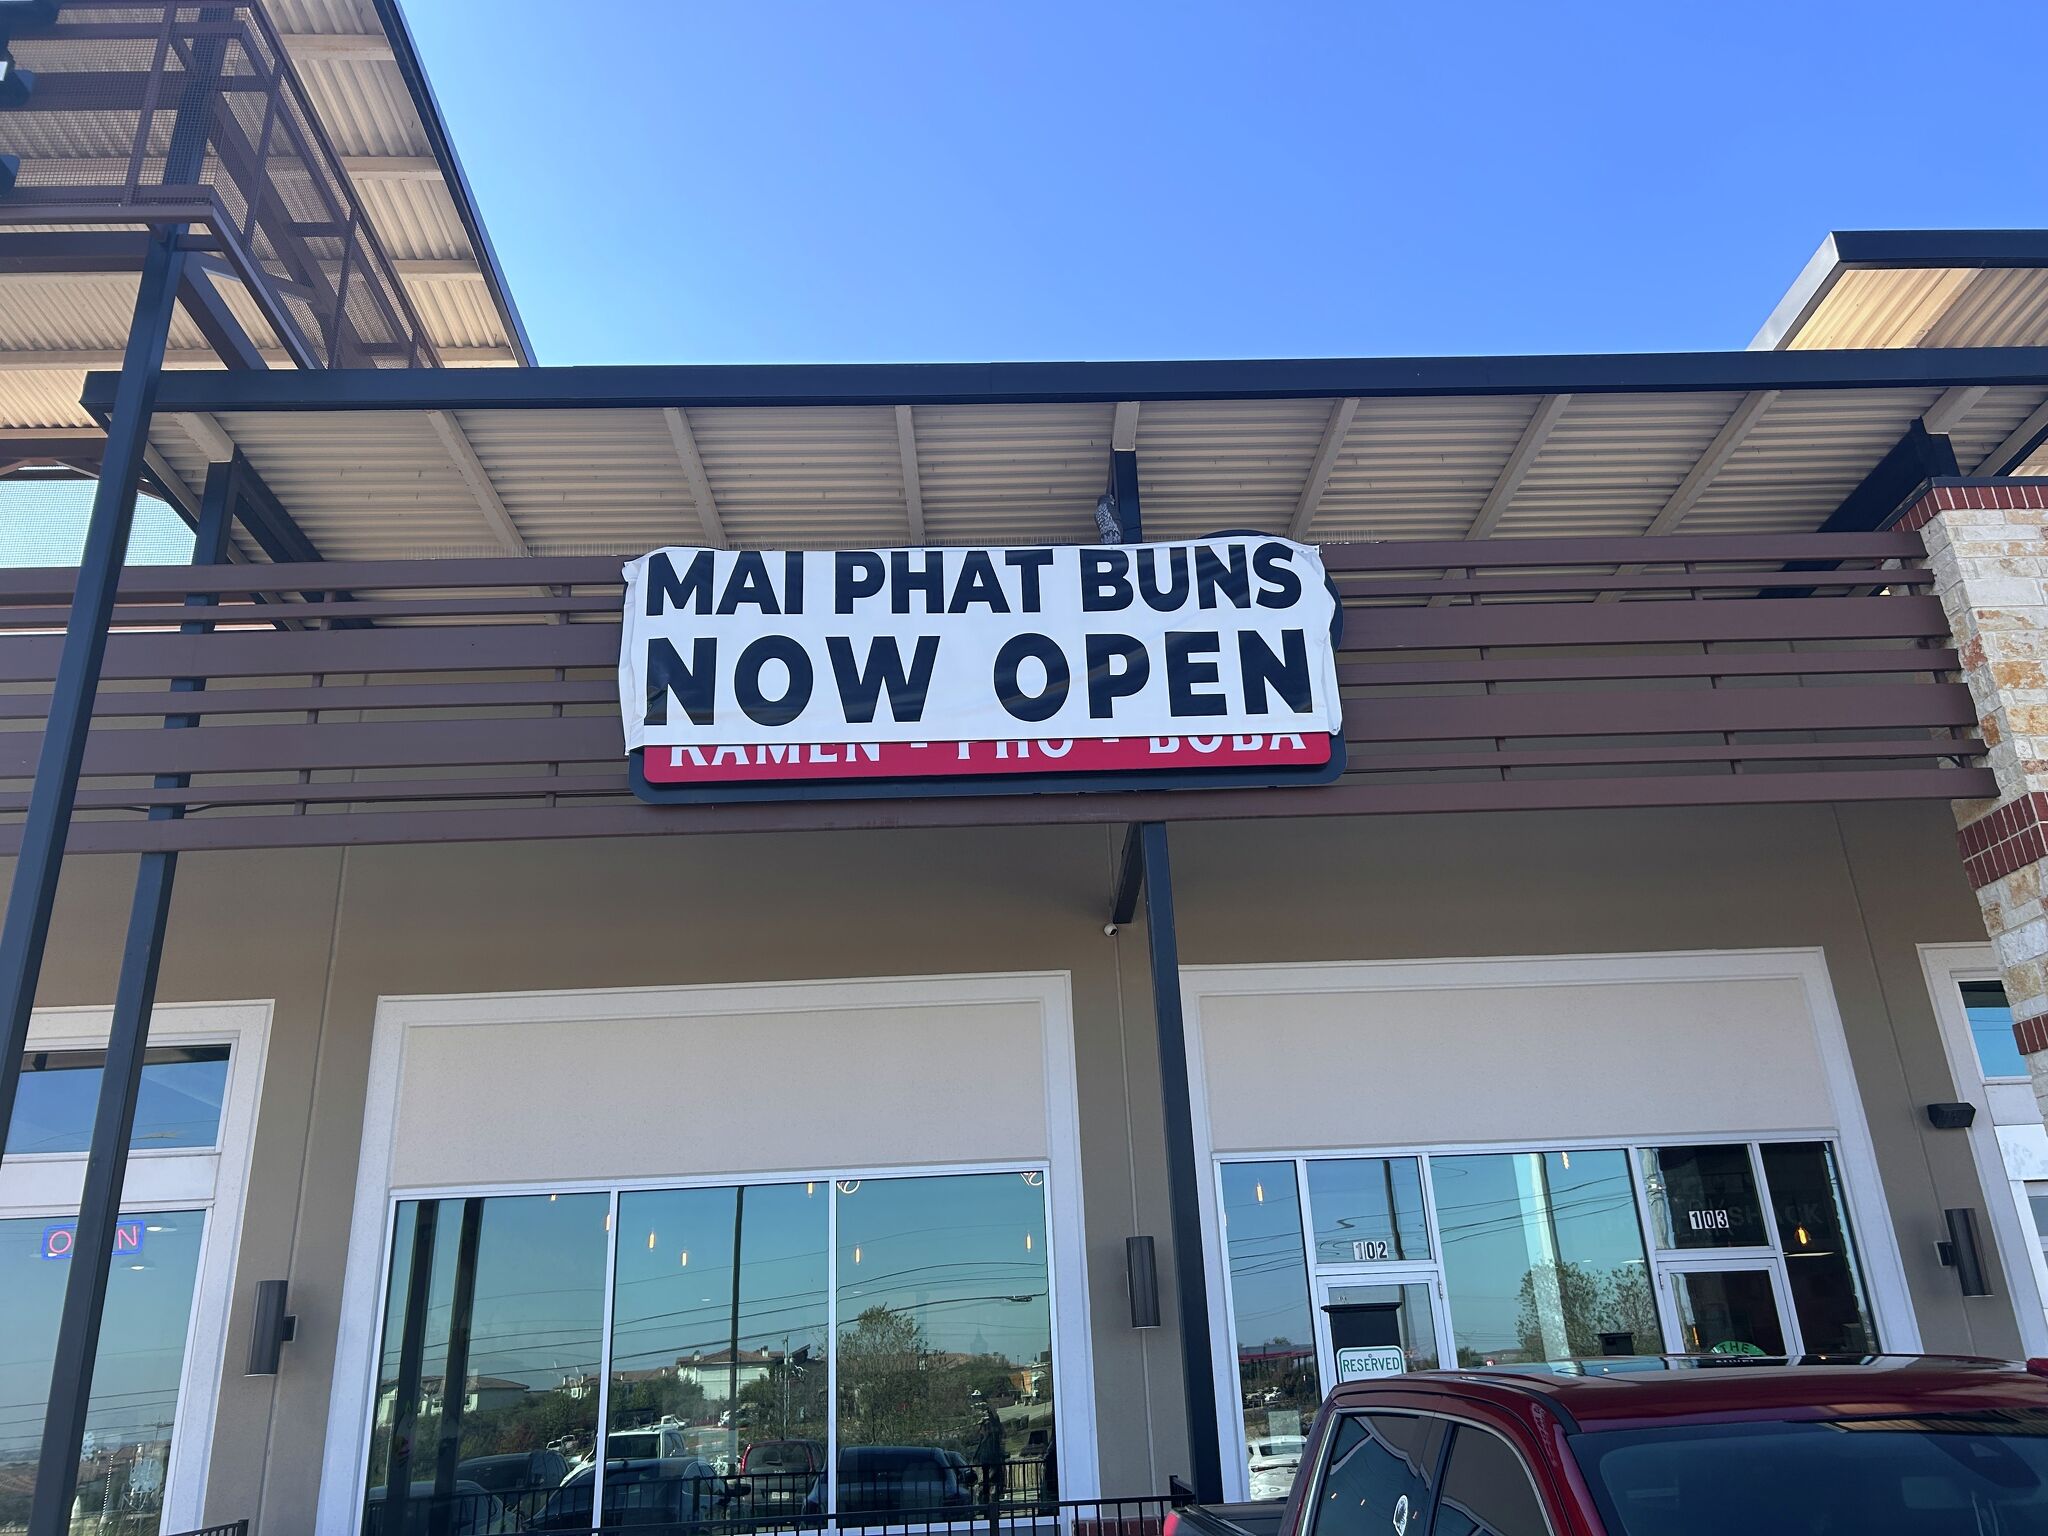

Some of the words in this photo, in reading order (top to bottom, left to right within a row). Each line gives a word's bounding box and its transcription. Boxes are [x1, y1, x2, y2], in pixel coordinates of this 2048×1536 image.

[646, 550, 803, 616] MAI
[834, 547, 1054, 615] PHAT
[1081, 542, 1302, 612] BUNS
[644, 634, 941, 726] NOW
[993, 628, 1313, 722] OPEN
[1690, 1210, 1728, 1229] 103
[49, 1225, 138, 1253] ON
[1354, 1241, 1388, 1260] 102
[1720, 1342, 1750, 1354] THE
[1343, 1356, 1400, 1373] RESERVED
